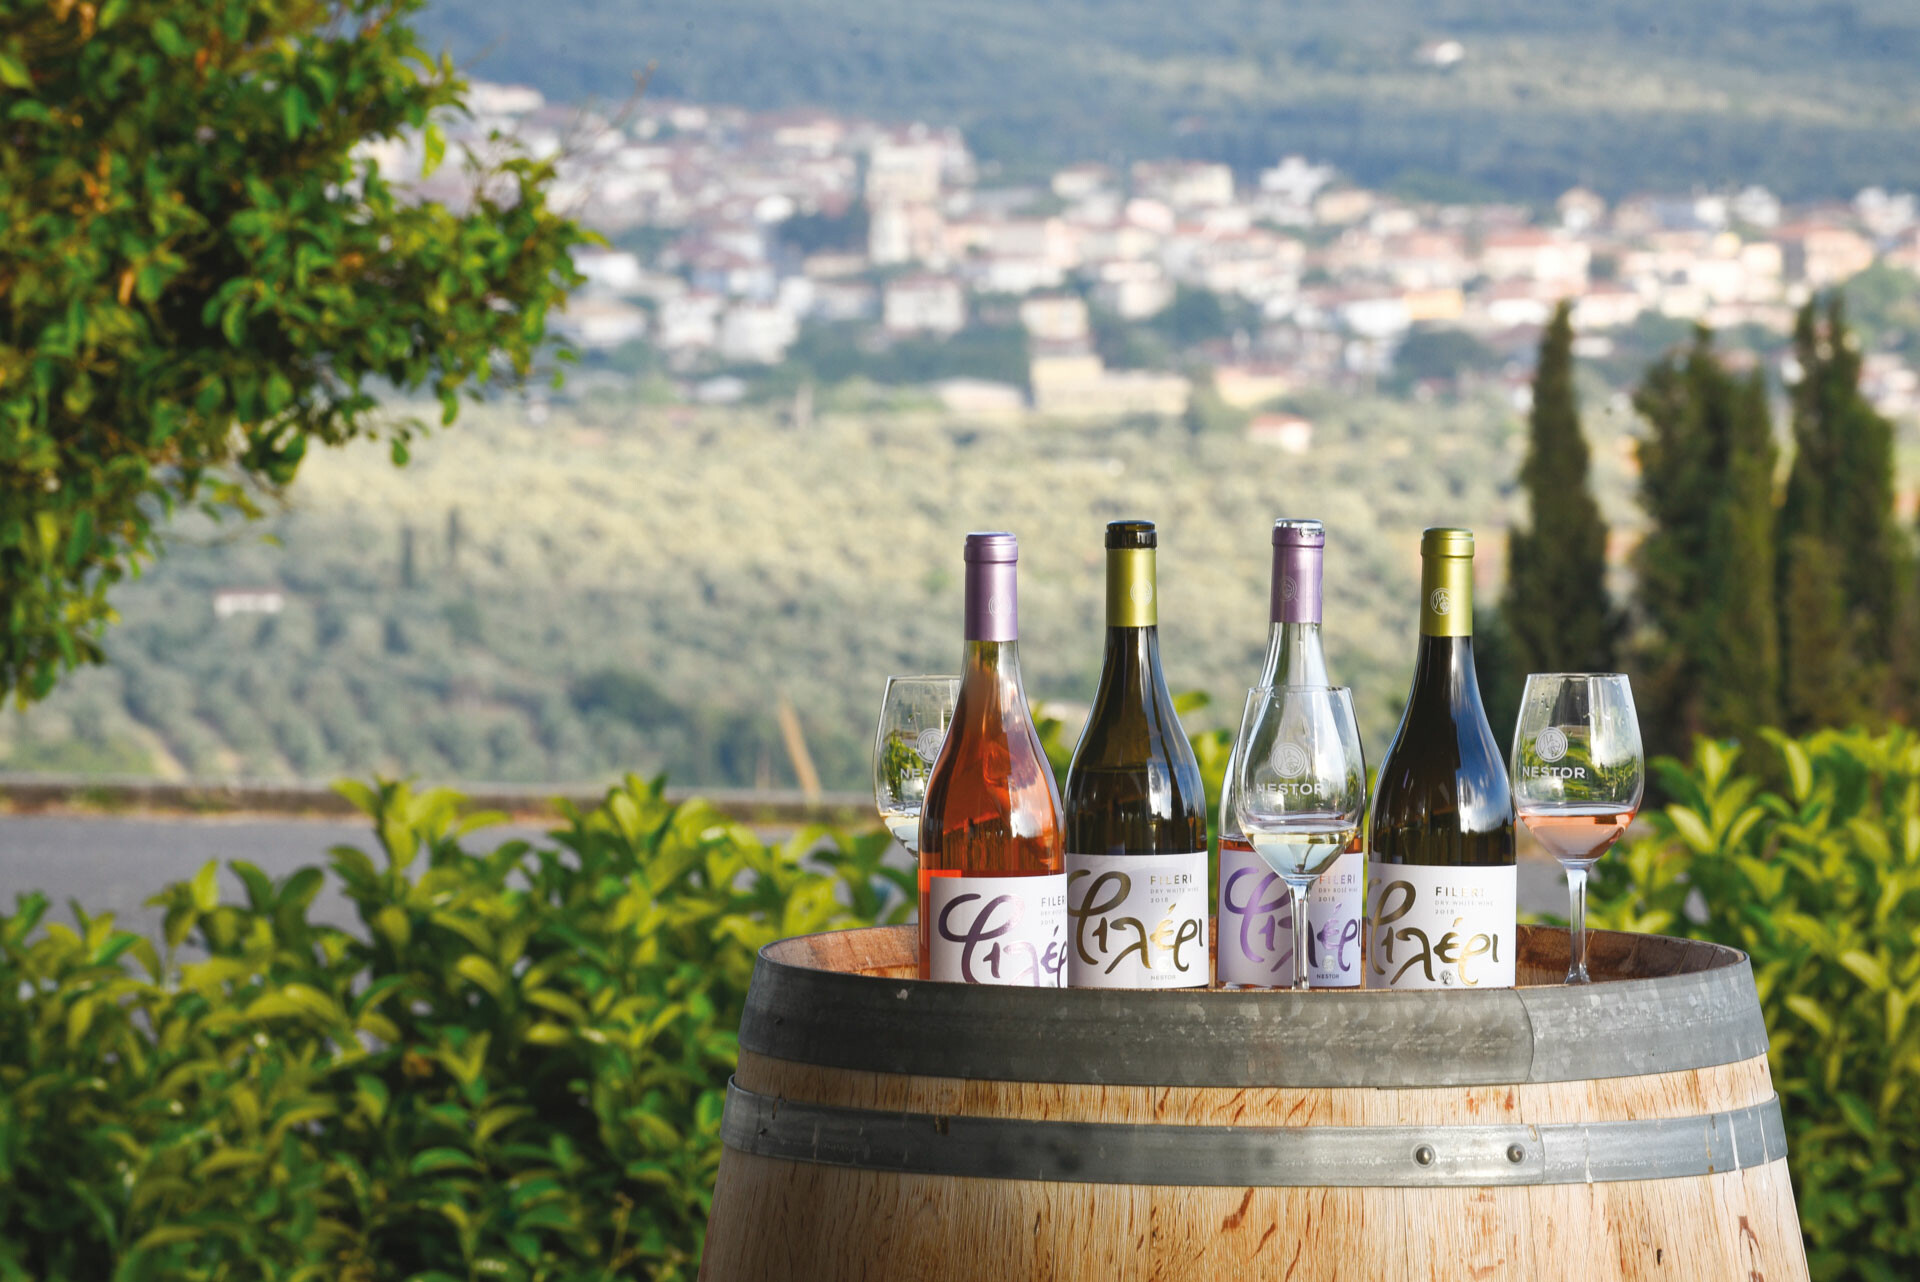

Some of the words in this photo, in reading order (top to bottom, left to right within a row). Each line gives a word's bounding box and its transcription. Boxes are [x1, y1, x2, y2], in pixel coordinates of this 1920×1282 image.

[900, 767, 930, 779] NES
[1522, 766, 1586, 778] NESTOR
[1255, 783, 1325, 795] NESTOR
[1150, 873, 1192, 885] FILERI
[1319, 874, 1356, 884] FILERI
[1435, 886, 1485, 897] FILERI
